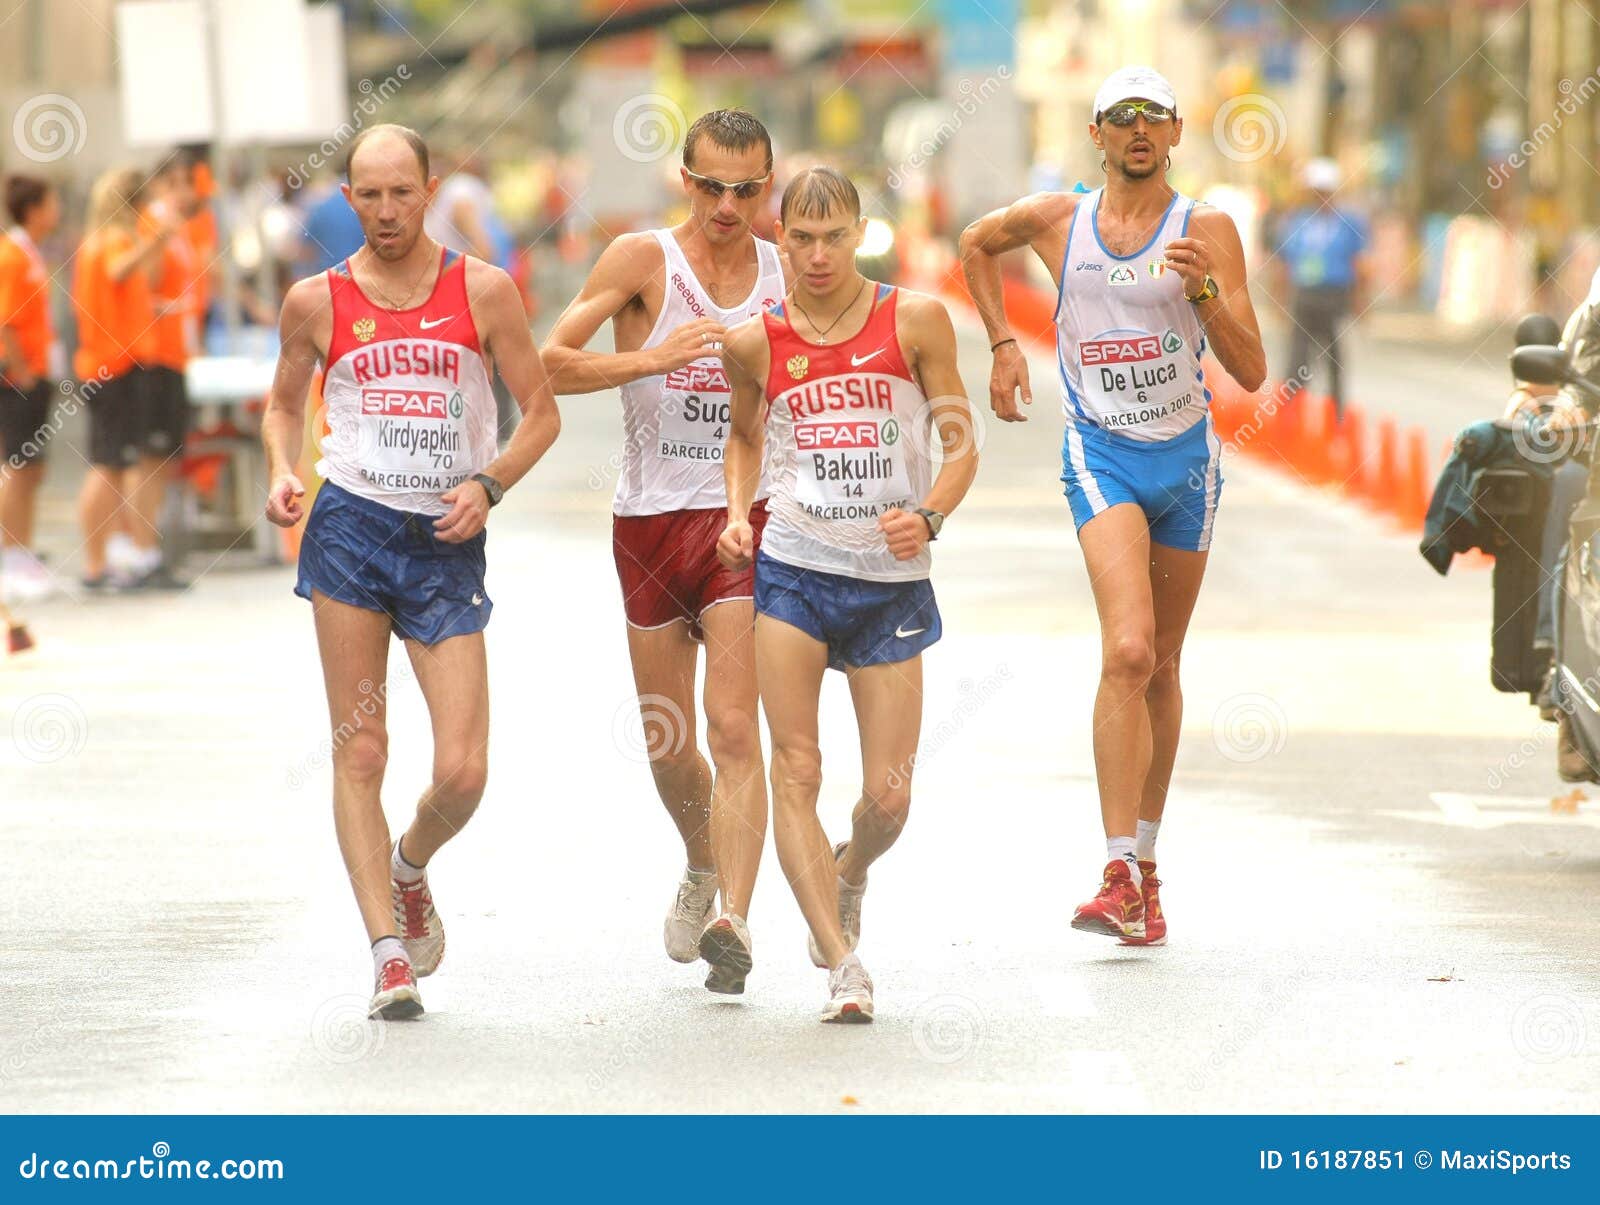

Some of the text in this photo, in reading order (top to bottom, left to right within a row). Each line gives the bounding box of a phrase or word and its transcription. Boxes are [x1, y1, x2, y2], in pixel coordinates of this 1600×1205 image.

[671, 273, 706, 318] Reebok
[1081, 338, 1160, 363] SPAR
[352, 344, 460, 385] RUSSIA
[667, 368, 731, 390] SPA
[1100, 362, 1177, 392] De Luca
[362, 391, 446, 416] SPAR
[786, 378, 893, 422] RUSSIA
[1136, 390, 1148, 404] 6
[1170, 393, 1192, 412] 2010
[378, 419, 460, 456] Kirdyapkin
[713, 426, 724, 440] 4
[796, 425, 878, 447] SPAR
[432, 454, 454, 470] 70
[662, 443, 725, 460] BARCELO
[813, 452, 893, 481] Bakulin
[843, 483, 864, 498] 14
